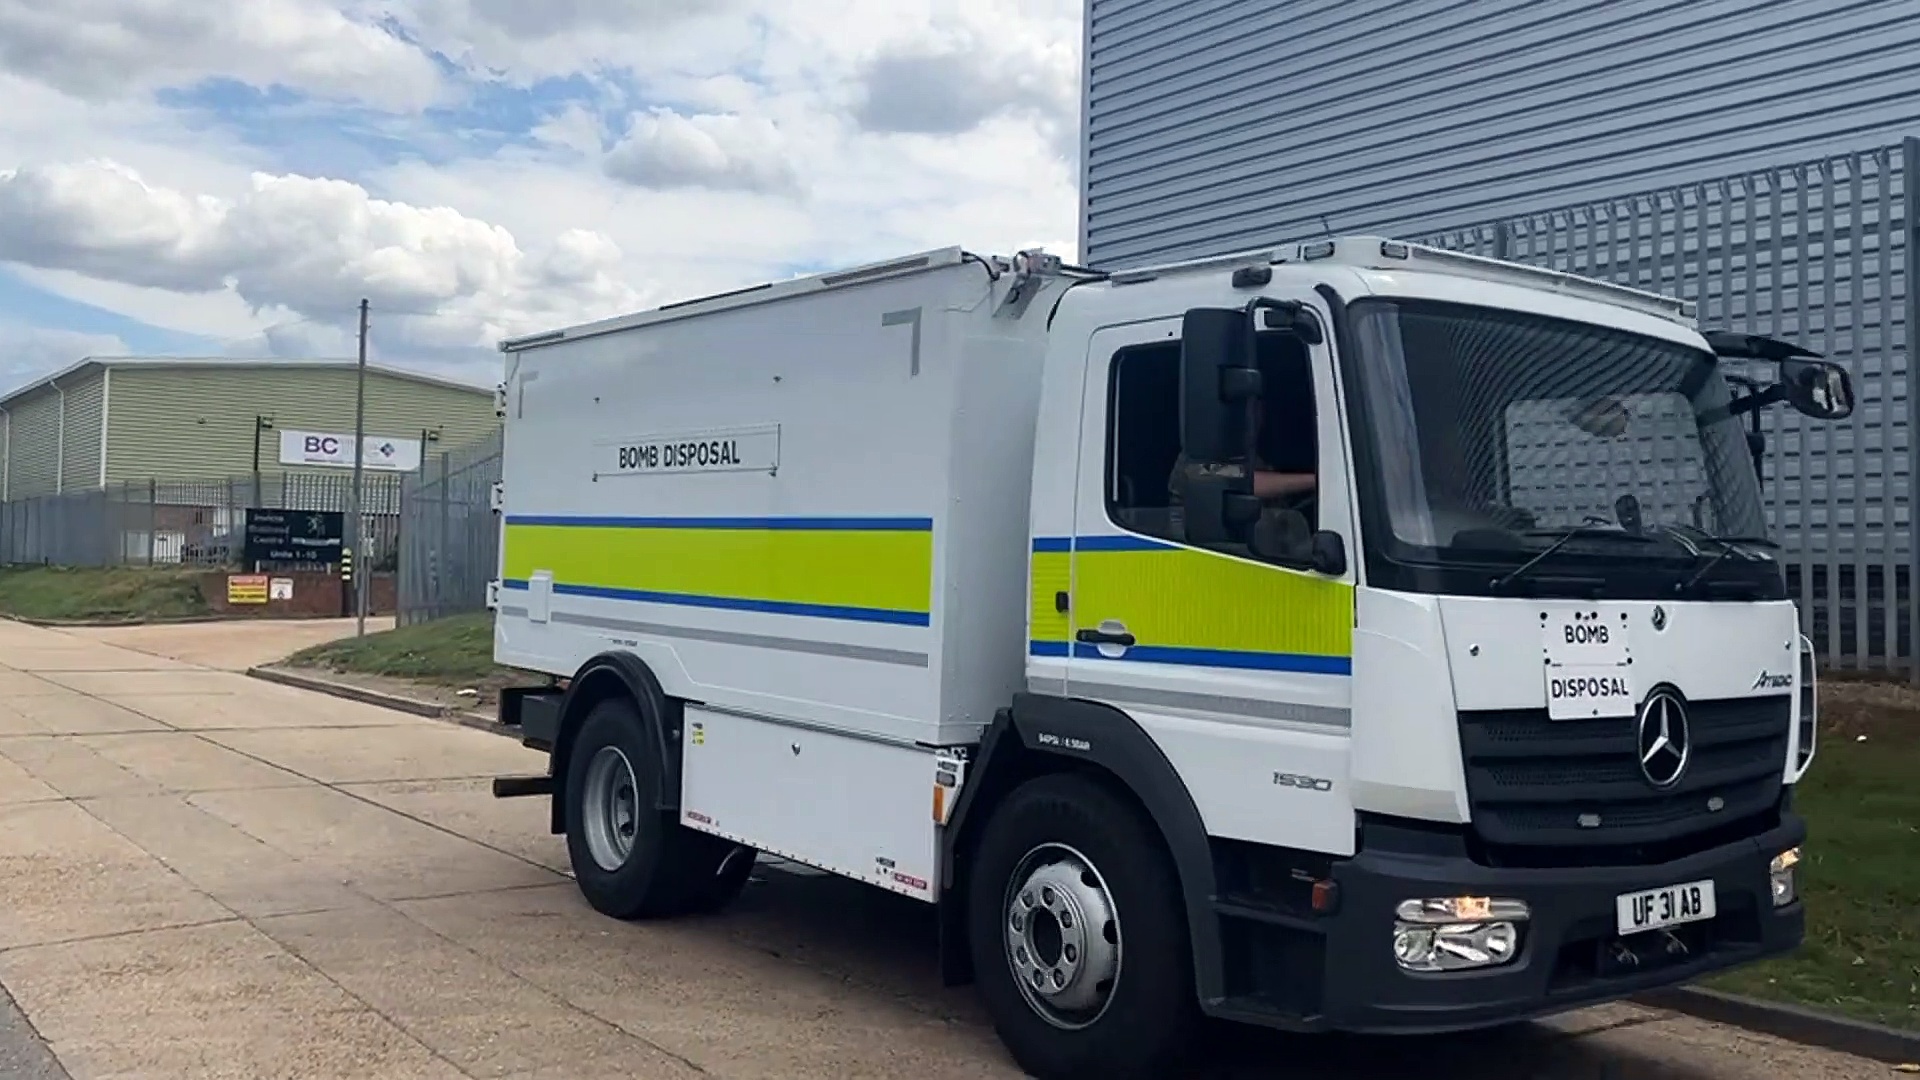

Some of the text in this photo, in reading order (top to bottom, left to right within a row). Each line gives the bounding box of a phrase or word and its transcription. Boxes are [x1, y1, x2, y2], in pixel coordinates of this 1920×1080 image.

[304, 436, 338, 455] BC
[619, 440, 740, 468] BOMB DISPOSAL
[1564, 624, 1609, 644] BOMB
[1551, 678, 1629, 699] DISPOSAL
[1273, 772, 1332, 791] 1530
[1633, 887, 1701, 925] UF 31 AB
